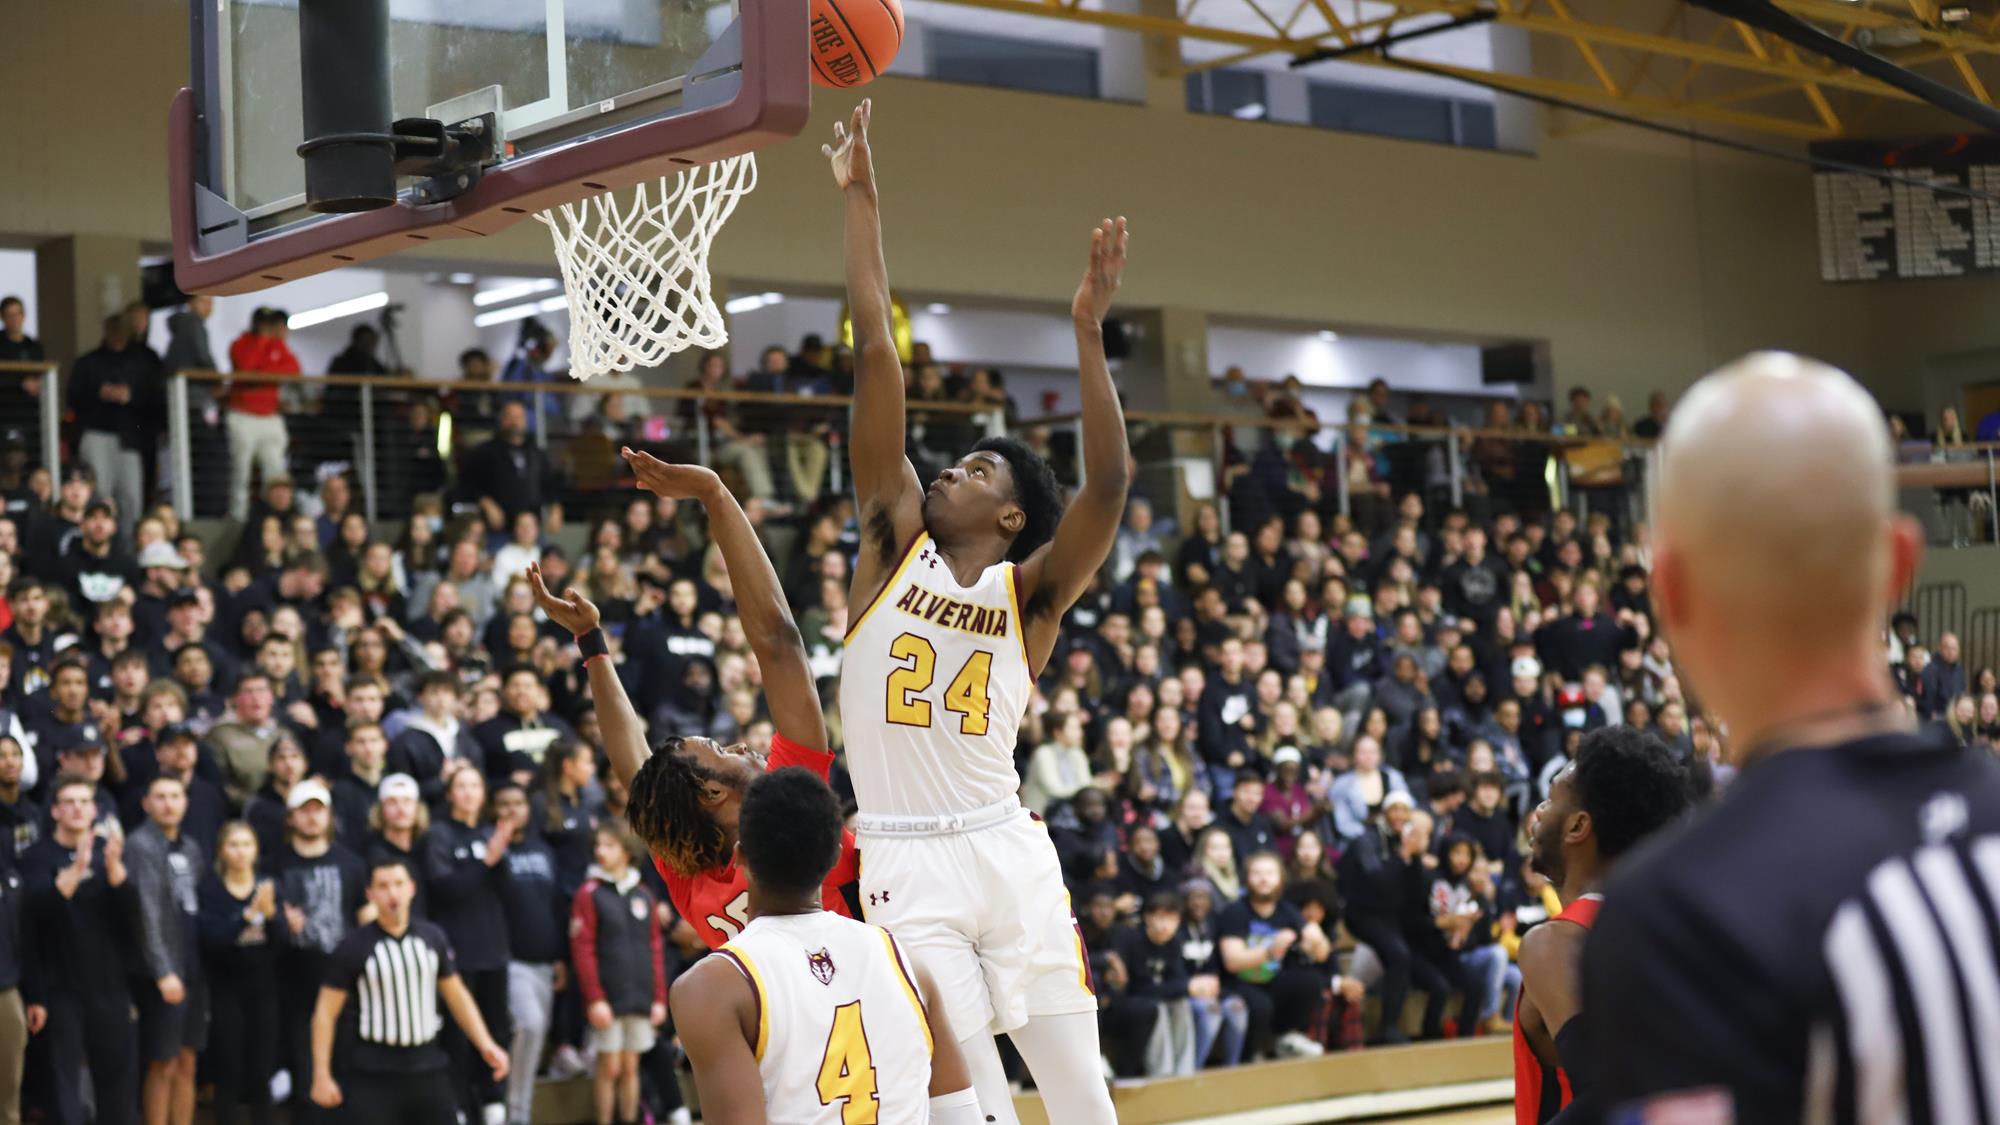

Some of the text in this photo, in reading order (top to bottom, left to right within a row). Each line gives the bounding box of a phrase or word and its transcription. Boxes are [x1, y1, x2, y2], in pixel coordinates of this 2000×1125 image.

[811, 13, 845, 53] THE
[895, 583, 1009, 638] ALVERNIA
[885, 631, 994, 736] 24
[815, 999, 880, 1125] 4
